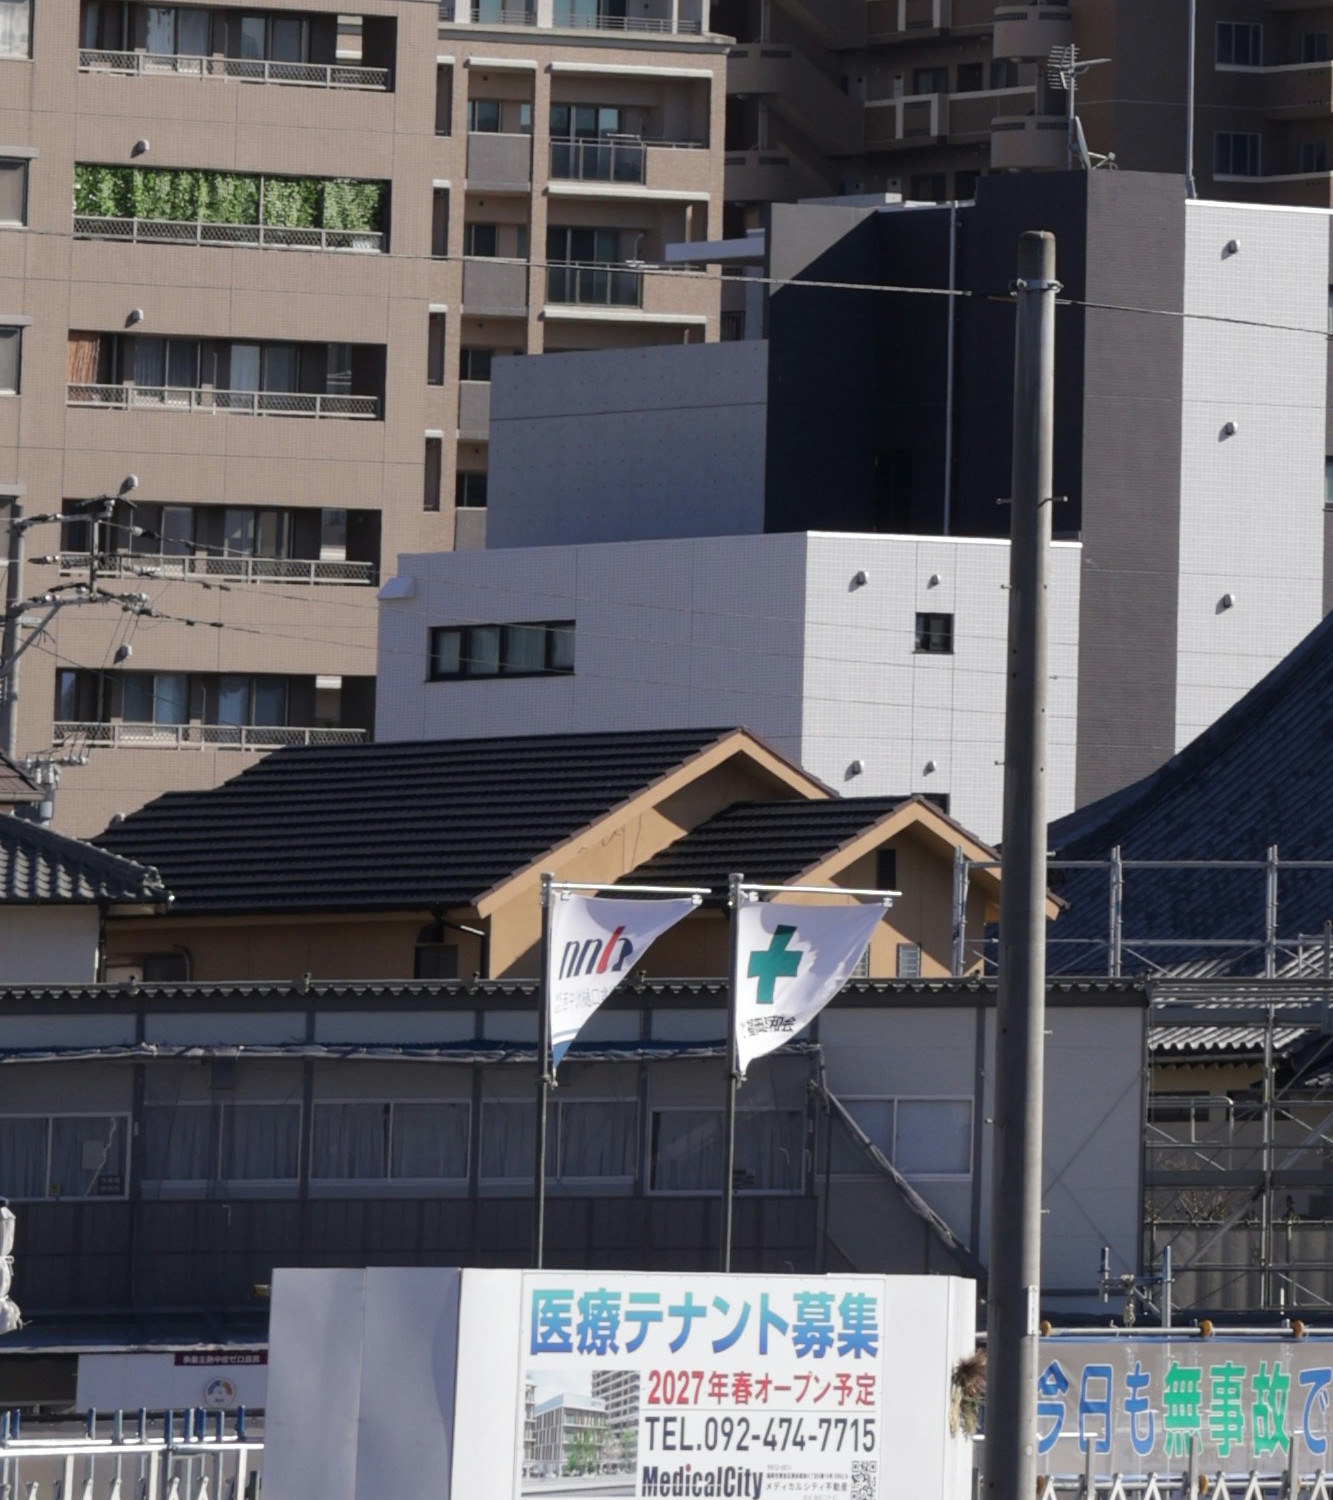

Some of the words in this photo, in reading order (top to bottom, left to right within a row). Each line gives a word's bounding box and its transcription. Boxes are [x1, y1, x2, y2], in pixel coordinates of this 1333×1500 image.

[530, 1287, 880, 1360] 医療テナント募集
[647, 1369, 877, 1406] 2027年春オープン予定
[645, 1416, 876, 1453] TEL.092-474-7715
[641, 1463, 764, 1500] MedicalCity
